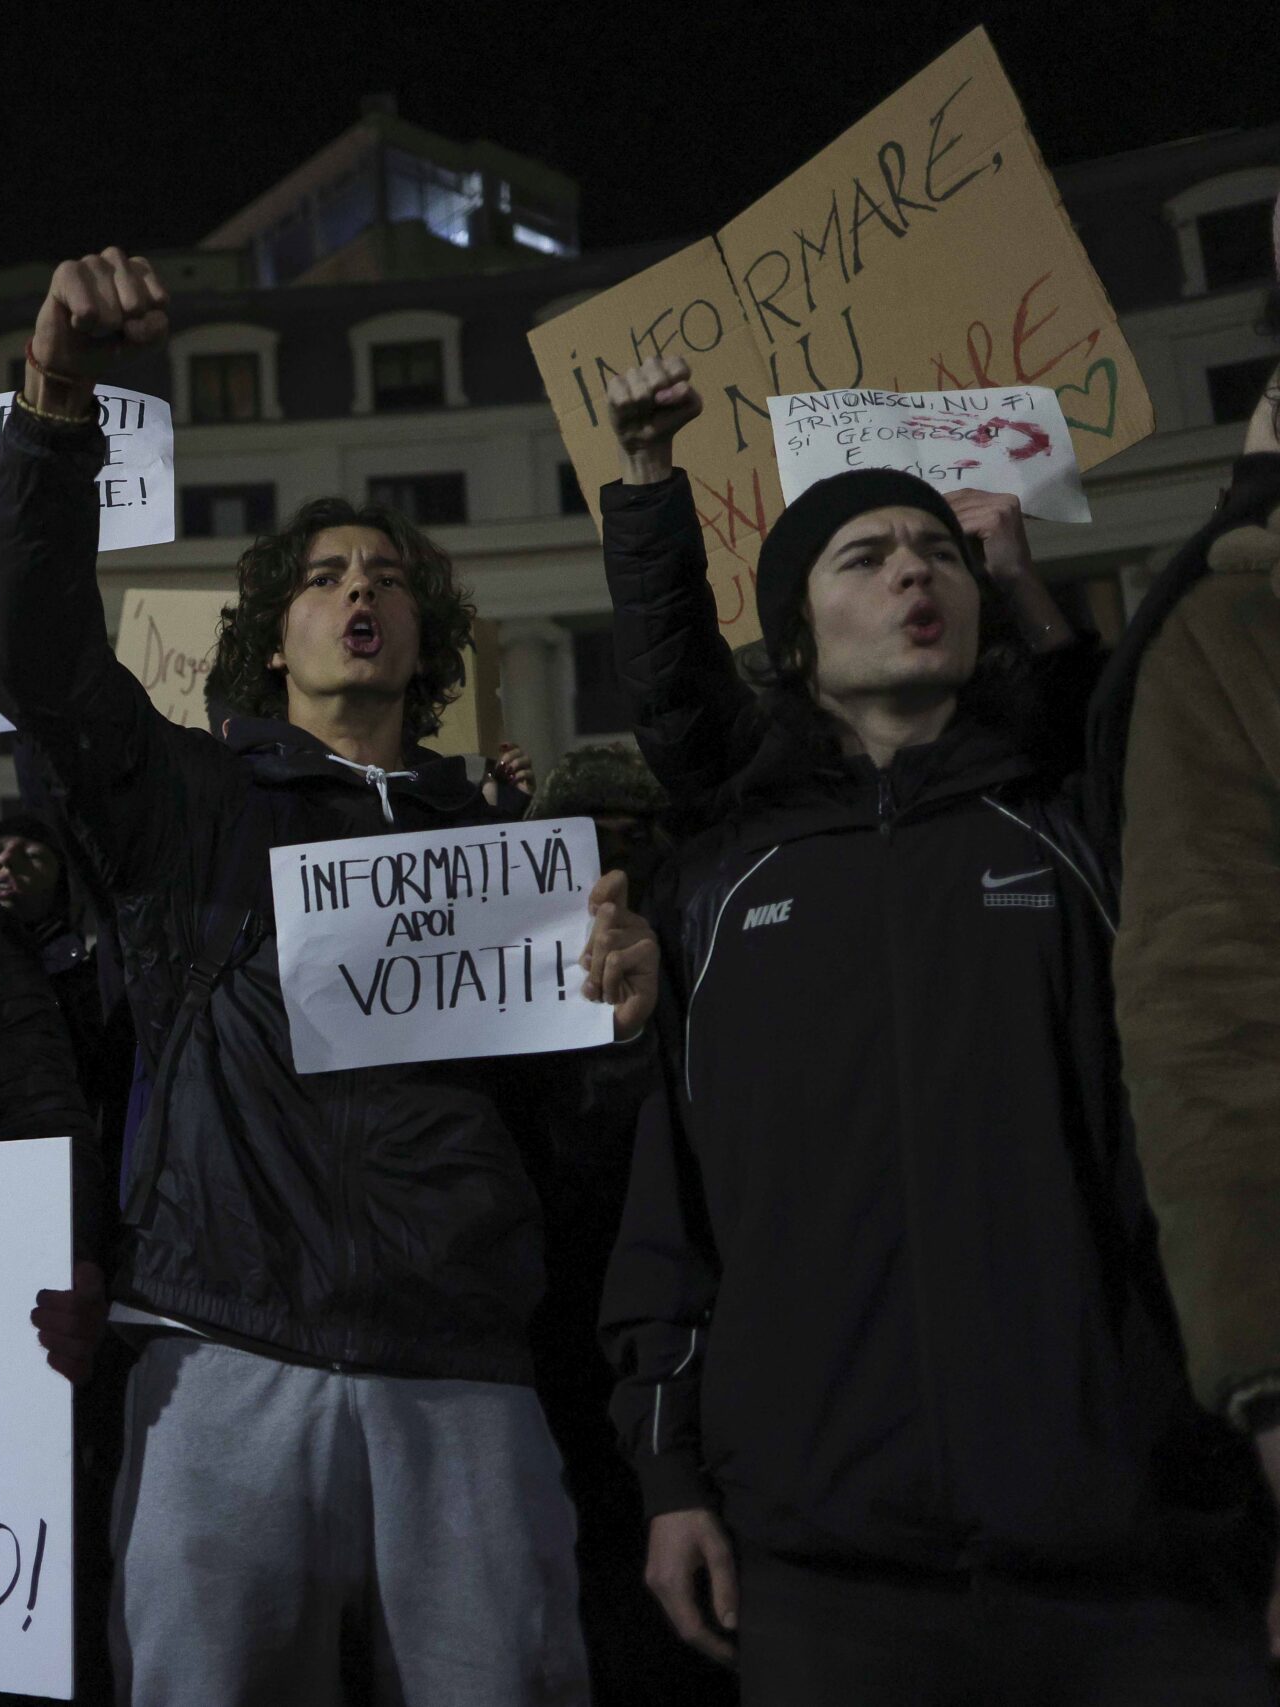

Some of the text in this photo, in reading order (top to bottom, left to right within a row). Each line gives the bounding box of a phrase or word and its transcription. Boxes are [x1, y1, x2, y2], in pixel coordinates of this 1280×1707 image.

[724, 306, 864, 453] NU
[945, 394, 989, 412] NU
[846, 447, 864, 467] E
[742, 897, 795, 931] NIKE
